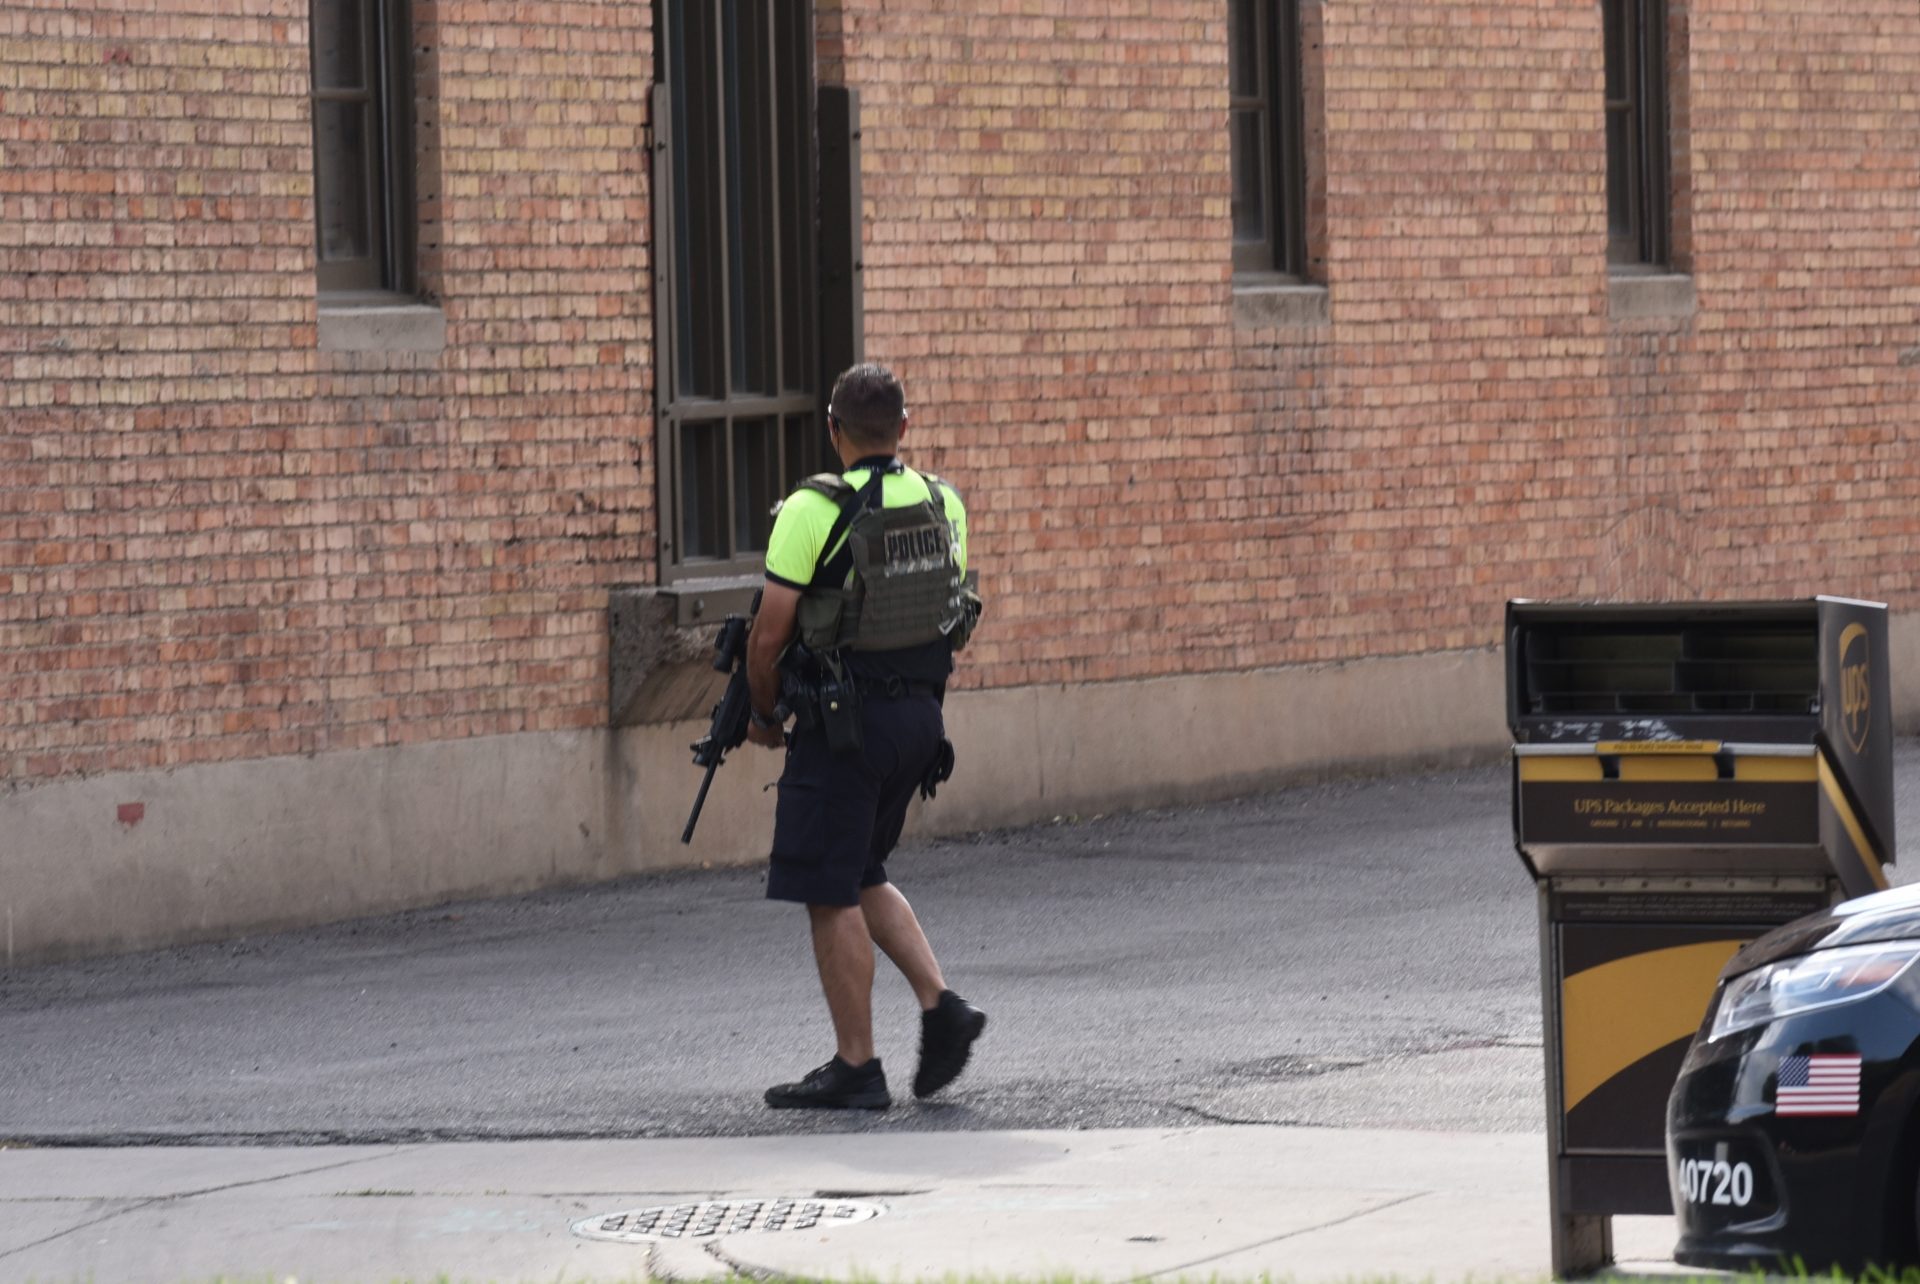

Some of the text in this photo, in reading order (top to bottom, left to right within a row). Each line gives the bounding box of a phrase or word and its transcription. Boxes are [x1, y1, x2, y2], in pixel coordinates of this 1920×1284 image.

[887, 527, 942, 561] POLICE
[1841, 662, 1869, 735] ups
[1574, 798, 1766, 816] UPS Packages Accepted Here
